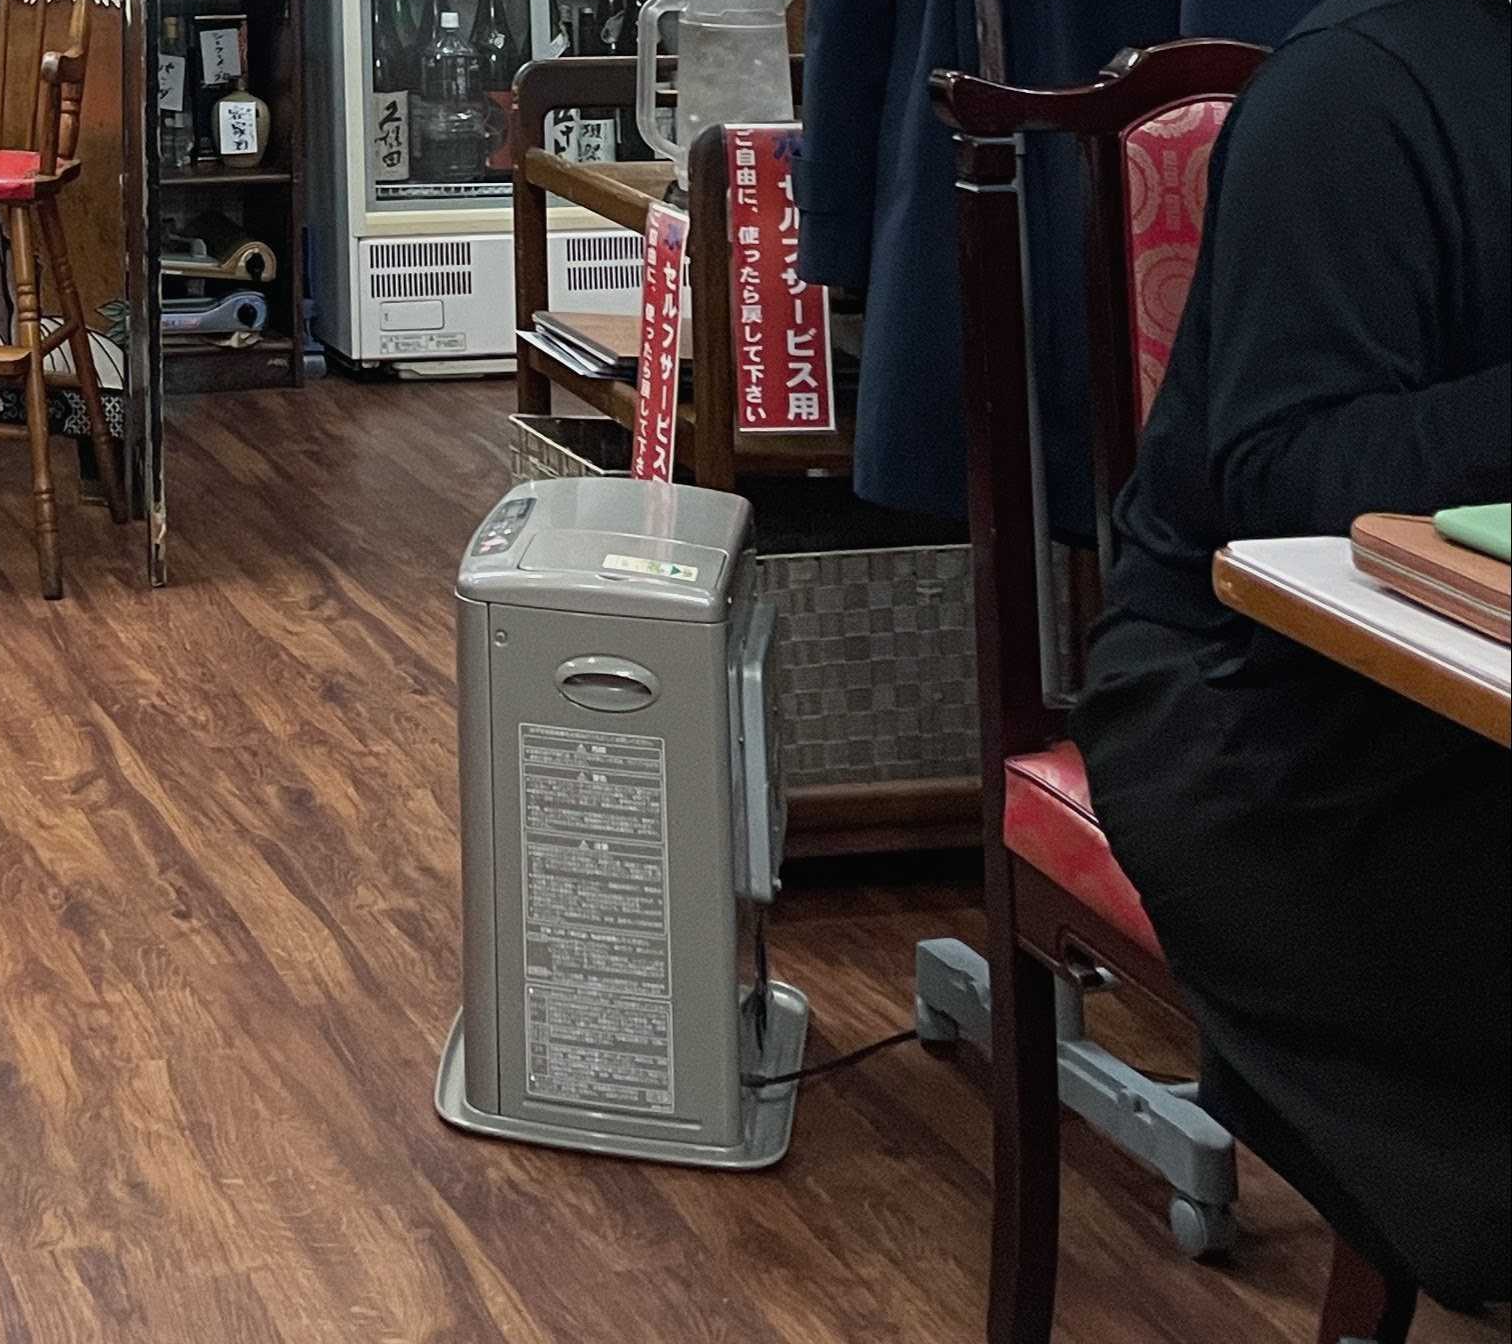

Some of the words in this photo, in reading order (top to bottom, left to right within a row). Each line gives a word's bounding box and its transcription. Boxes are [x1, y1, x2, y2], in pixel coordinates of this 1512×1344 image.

[374, 100, 402, 167] 久保田
[651, 261, 678, 483] セルフサービス
